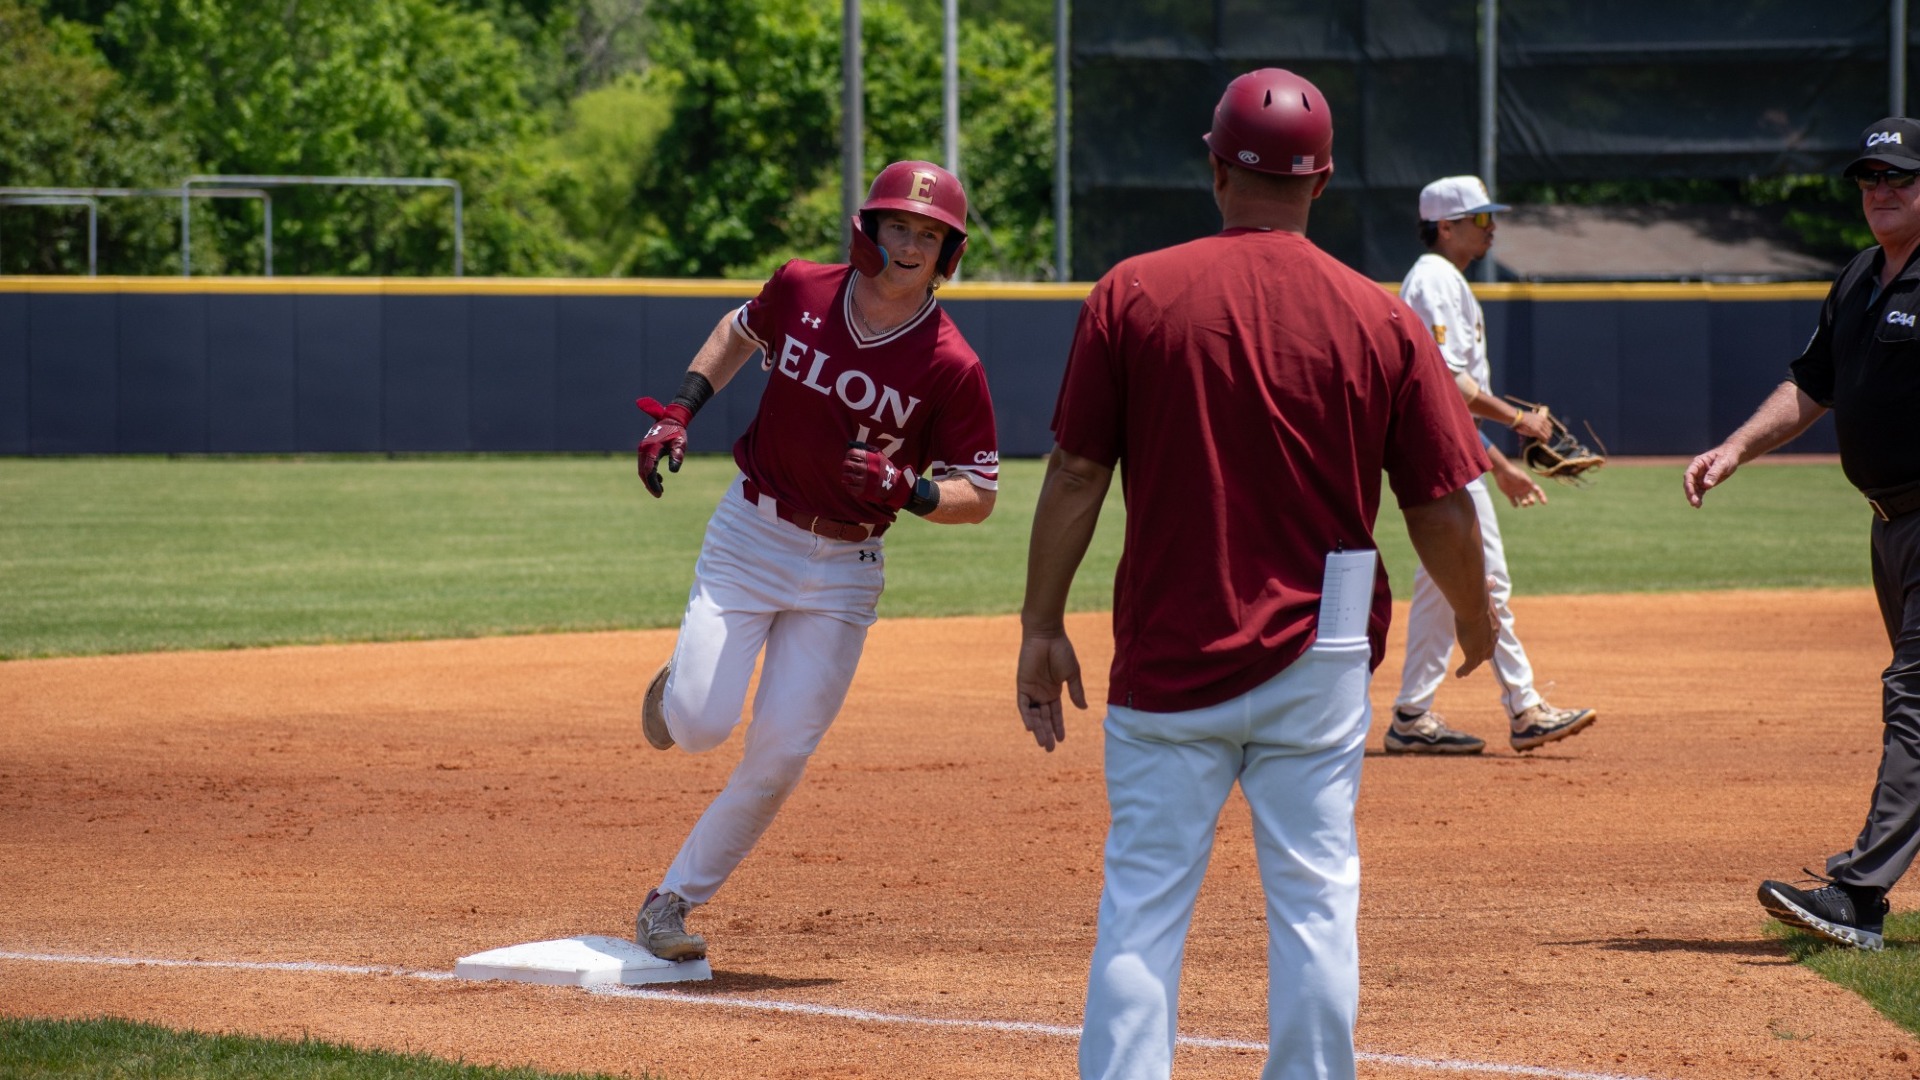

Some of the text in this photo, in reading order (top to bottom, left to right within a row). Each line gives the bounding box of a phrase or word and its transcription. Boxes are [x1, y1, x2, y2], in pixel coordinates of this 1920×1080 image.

[1866, 131, 1902, 147] CAA
[906, 171, 937, 204] E
[1887, 310, 1916, 327] CAA
[778, 333, 921, 428] ELON
